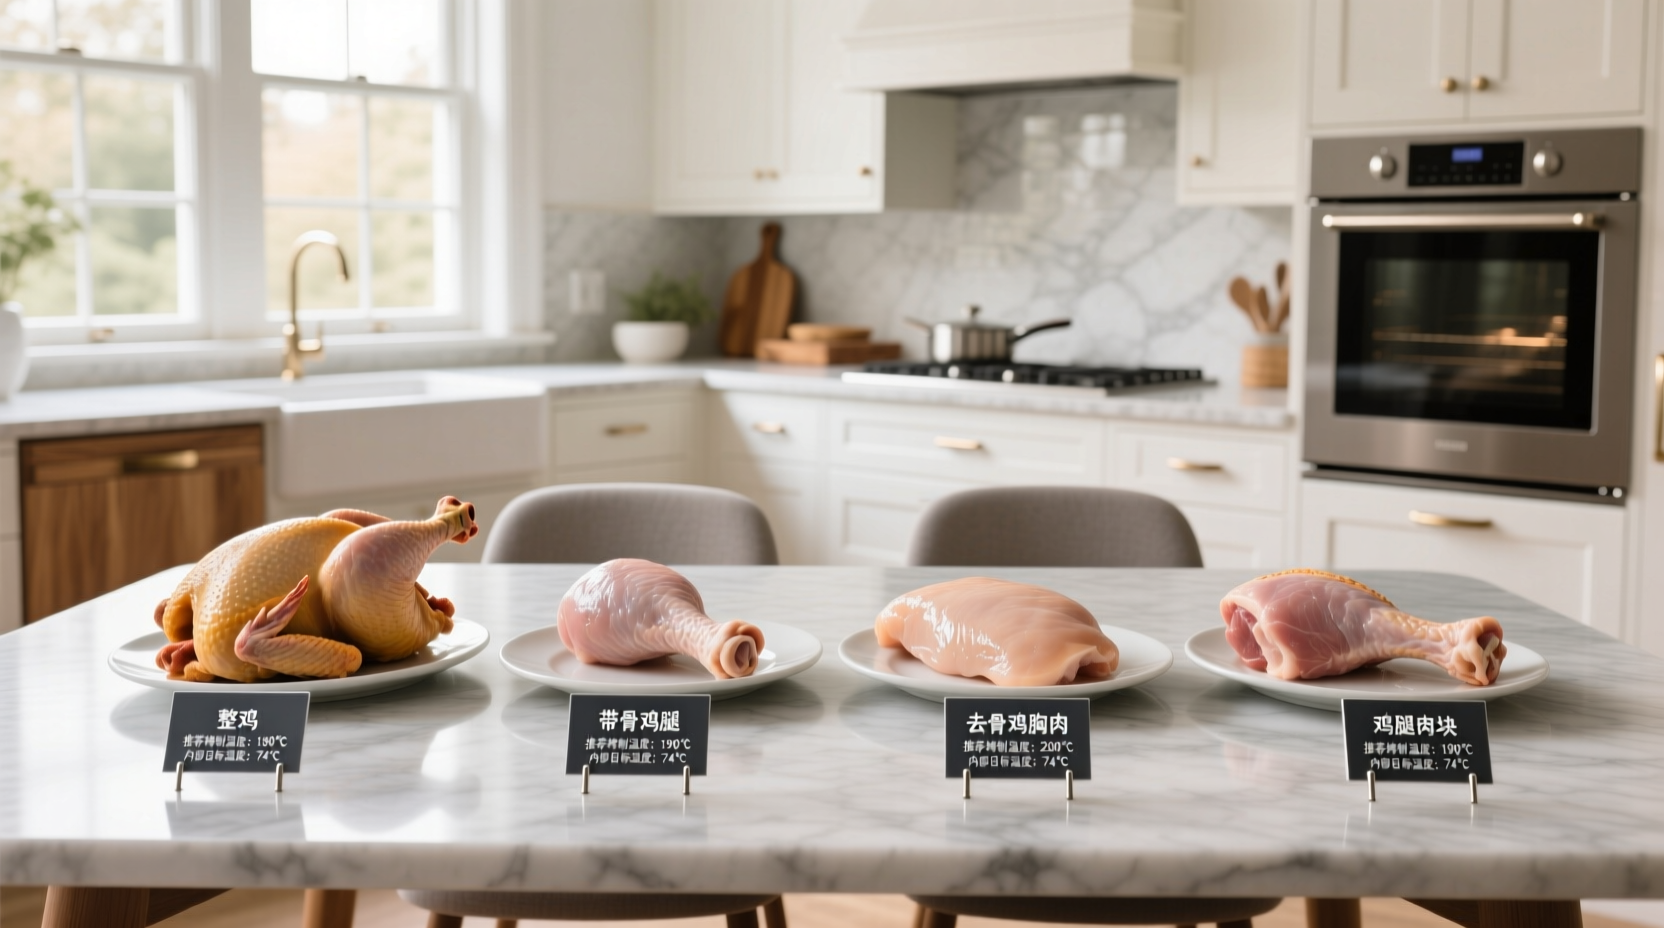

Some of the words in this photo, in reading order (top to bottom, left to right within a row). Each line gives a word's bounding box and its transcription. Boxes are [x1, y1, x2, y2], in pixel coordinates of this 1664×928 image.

[217, 708, 258, 730] 整鸡
[599, 709, 680, 732] 带骨鸡腿
[966, 712, 1068, 735] 去骨鸡胸肉
[1373, 713, 1457, 736] 鸡腿肉块
